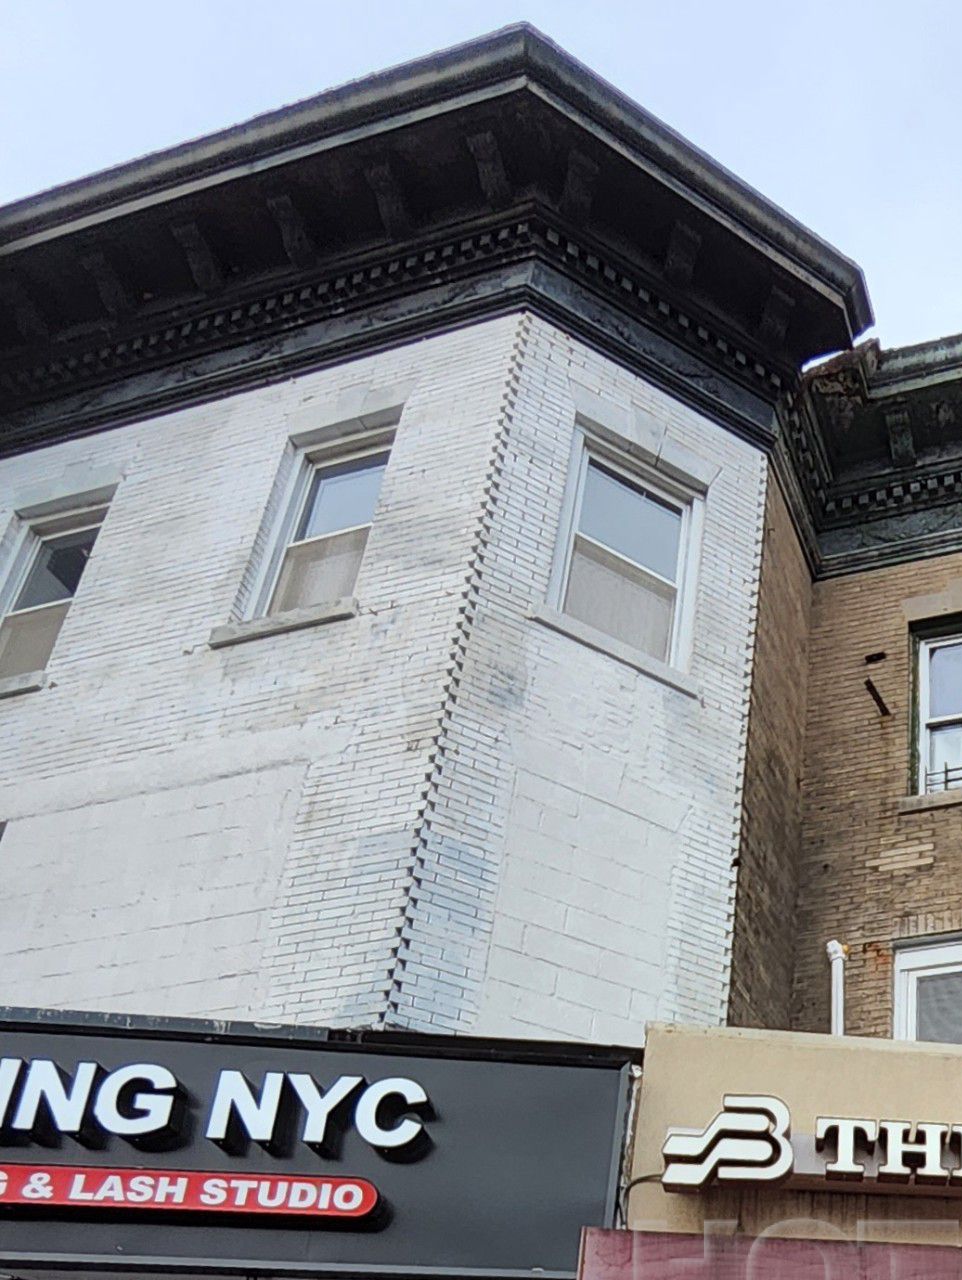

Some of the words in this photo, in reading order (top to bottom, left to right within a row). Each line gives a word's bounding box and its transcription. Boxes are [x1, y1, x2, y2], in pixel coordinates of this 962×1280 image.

[0, 1058, 177, 1134] ING
[206, 1069, 429, 1149] NYC
[22, 1172, 53, 1199] &
[69, 1174, 188, 1203] LASH
[199, 1177, 364, 1211] STUDIO
